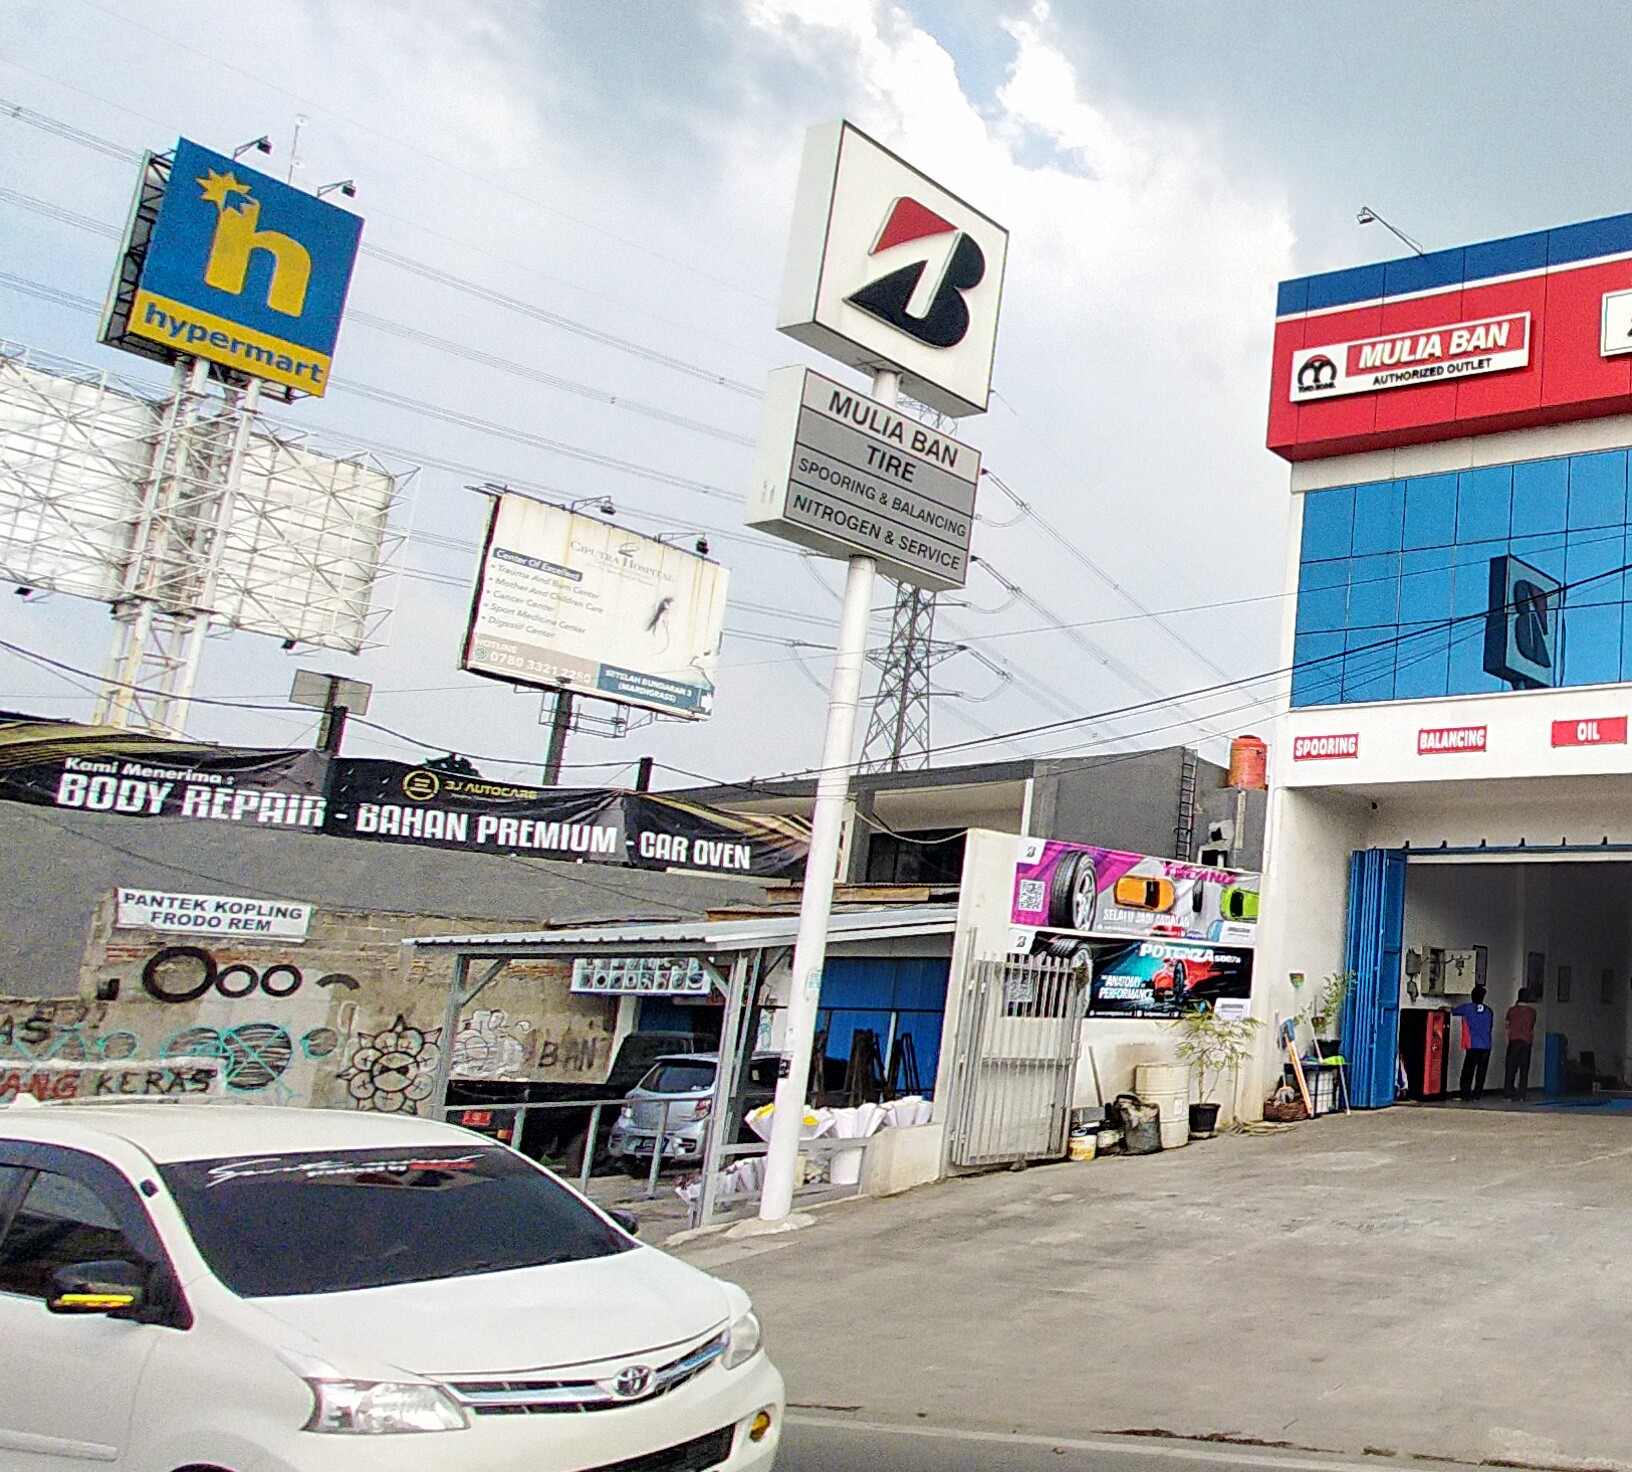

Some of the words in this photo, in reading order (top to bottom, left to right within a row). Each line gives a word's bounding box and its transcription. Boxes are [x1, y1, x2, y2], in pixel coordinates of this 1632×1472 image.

[144, 302, 324, 383] hypermart
[1359, 333, 1442, 369] MULIA
[1449, 321, 1510, 355] BAN
[1373, 366, 1444, 386] AUTHORIZED
[1449, 358, 1492, 374] OUTLET
[829, 391, 904, 446] MULIA
[911, 432, 958, 468] BAN
[867, 445, 917, 484] TIRE
[798, 458, 877, 504] SPOORING
[879, 490, 888, 506] &
[892, 498, 967, 538] BALANCING
[793, 496, 882, 540] NITROGEN
[884, 530, 894, 546] &
[898, 536, 961, 571] SERVICE
[496, 550, 526, 565] Center
[531, 573, 550, 585] And
[529, 588, 549, 598] And
[1419, 729, 1485, 749] BALANCING
[1576, 722, 1601, 741] OIL
[1295, 737, 1357, 757] SPOORING
[65, 756, 118, 773] Kami
[121, 762, 223, 784] Menerima
[464, 783, 538, 800] AUTOCARE
[56, 771, 175, 816] BODY
[180, 784, 328, 828] REPAIR
[356, 802, 468, 843] BAHAN
[477, 815, 618, 854] PREMIUM
[638, 831, 689, 863] CAR
[692, 840, 751, 870] OVEN
[123, 892, 209, 913] PANTEK
[214, 900, 303, 920] KOPLING
[150, 911, 222, 930] FRODO
[228, 917, 273, 932] REM
[1140, 943, 1214, 962] POTENZA
[1105, 974, 1141, 988] ANATOMY
[1098, 987, 1154, 1000] PERFORMANCE
